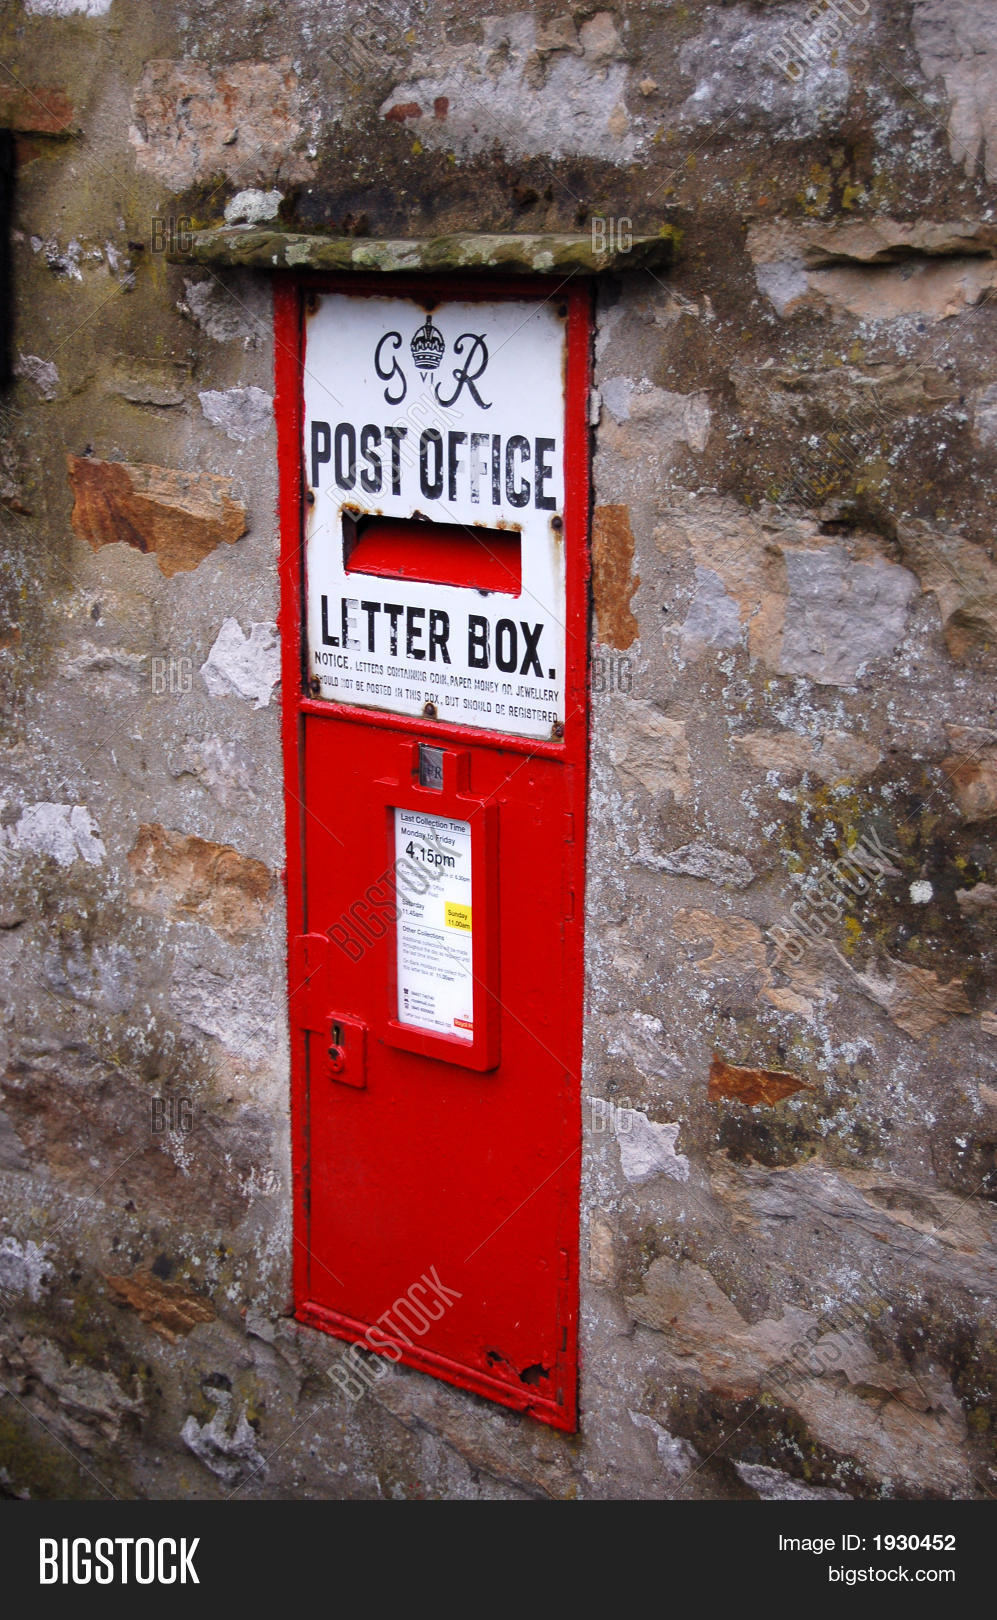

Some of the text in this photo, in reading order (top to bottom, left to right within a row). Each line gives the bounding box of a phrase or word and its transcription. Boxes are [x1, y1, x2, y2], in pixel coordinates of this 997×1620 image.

[374, 331, 493, 410] G R
[420, 371, 434, 384] VI
[311, 420, 557, 511] POST OFFICE
[321, 595, 556, 680] LETTER BOX.
[355, 661, 384, 676] LETTERS
[387, 666, 427, 682] CONTAINING
[474, 679, 499, 693] MONEY
[515, 685, 559, 703] JEWELLERY
[355, 680, 364, 692] BE
[366, 682, 392, 696] POSTED
[394, 687, 403, 698] IN
[405, 688, 422, 702] THIS
[463, 698, 492, 713] SHOULD
[401, 812, 466, 833] Last Collection Time
[401, 826, 456, 847] Monday to Friday
[405, 840, 456, 868] 4.15pm
[402, 898, 425, 911] Saturday
[447, 909, 468, 920] Sunday
[402, 925, 445, 940] Other Collections
[448, 919, 471, 930] 11.00am
